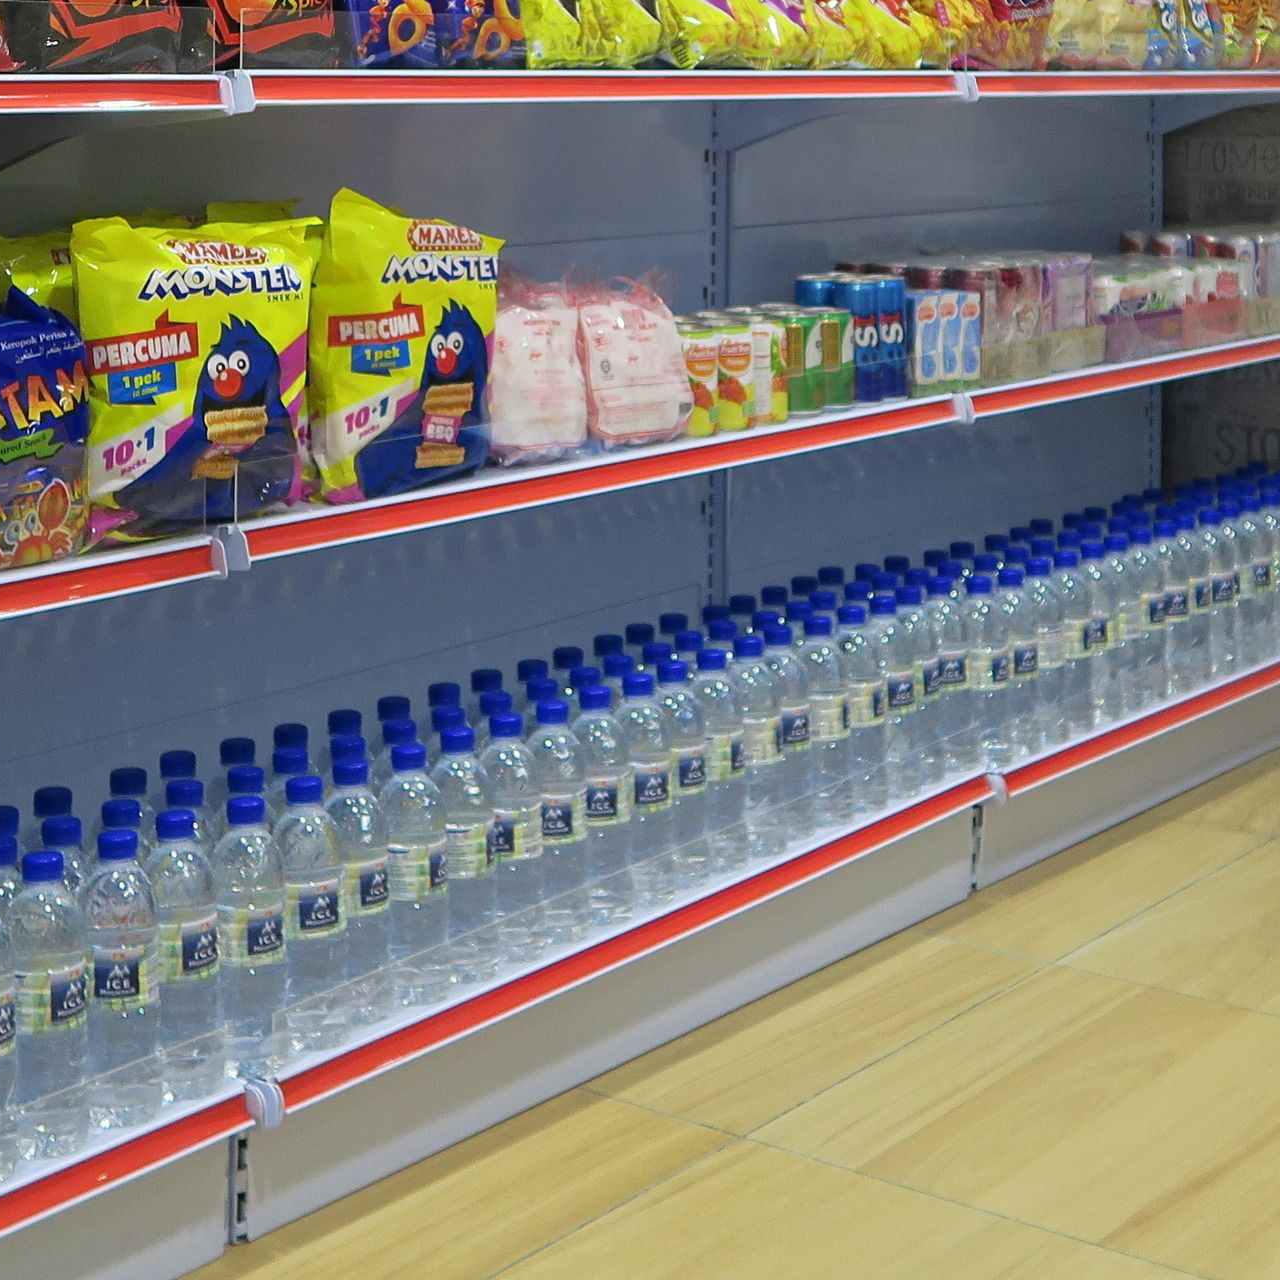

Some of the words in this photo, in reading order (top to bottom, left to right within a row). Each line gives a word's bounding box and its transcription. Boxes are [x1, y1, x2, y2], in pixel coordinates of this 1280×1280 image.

[419, 226, 478, 247] MAMEE
[181, 243, 260, 264] MAMEE
[340, 313, 420, 342] PERCUMA
[92, 332, 191, 369] PERCUMA
[375, 346, 399, 364] pek
[136, 371, 163, 390] pek
[426, 423, 454, 441] BBQ
[121, 457, 147, 477] packs
[106, 979, 131, 990] ICE
